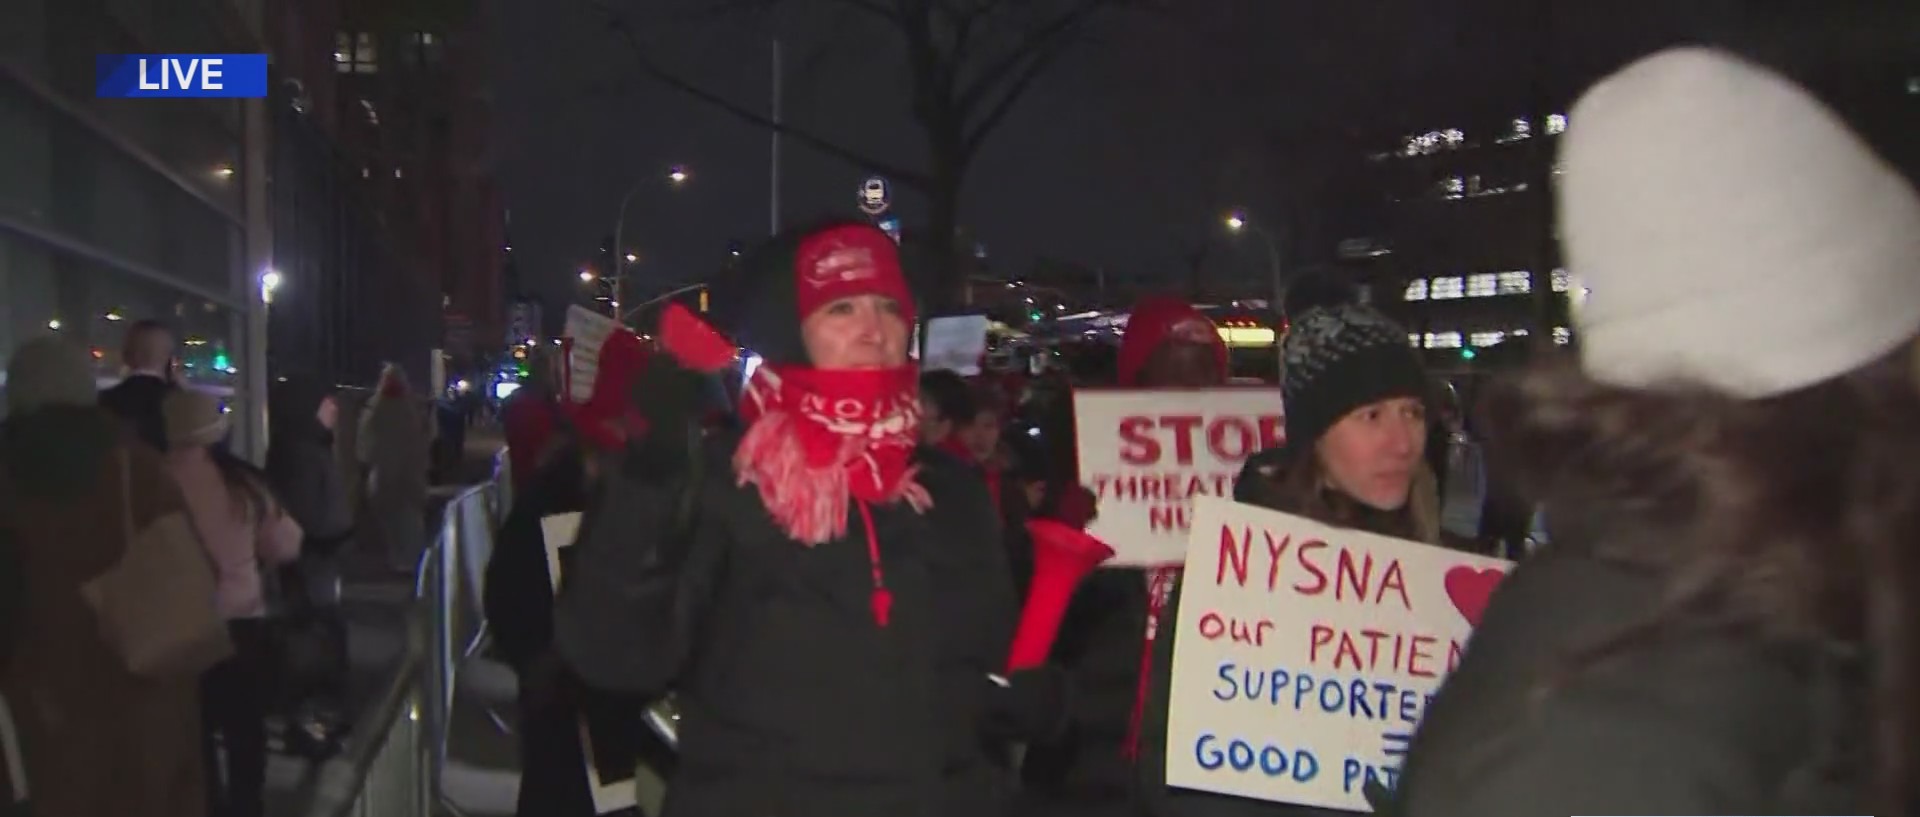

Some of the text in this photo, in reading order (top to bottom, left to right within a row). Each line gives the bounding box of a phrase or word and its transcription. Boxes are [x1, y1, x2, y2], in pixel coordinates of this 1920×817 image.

[1093, 473, 1239, 501] THREAT
[1216, 524, 1412, 611] NYSNA
[1213, 663, 1432, 723] SUPPORTE
[1195, 734, 1319, 782] GOOD
